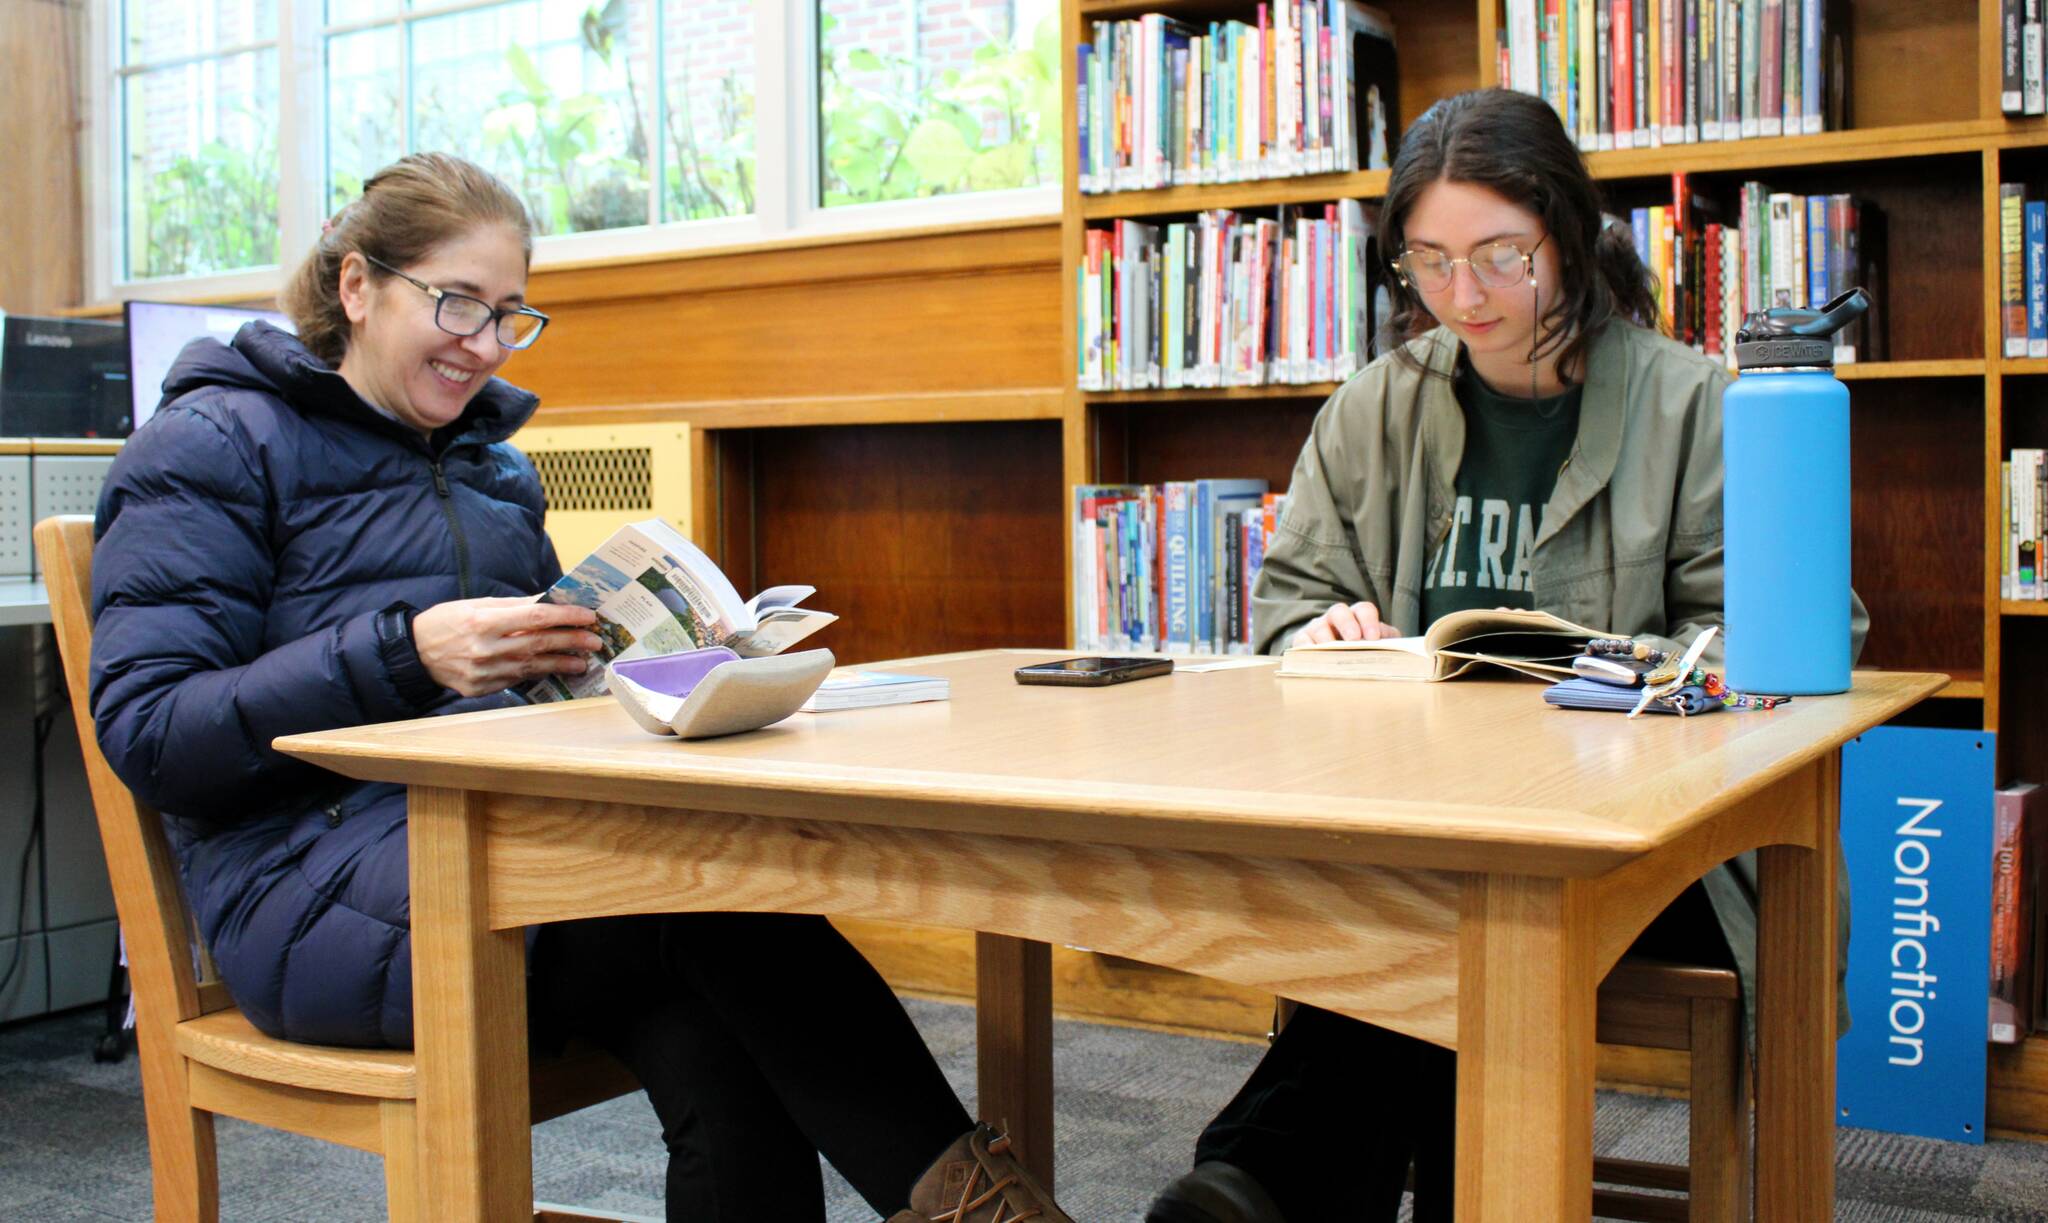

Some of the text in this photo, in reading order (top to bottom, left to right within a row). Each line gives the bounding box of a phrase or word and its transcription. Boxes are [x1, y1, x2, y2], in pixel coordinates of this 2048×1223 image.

[26, 331, 72, 348] Lenovo
[1169, 535, 1186, 633] QUILTING
[2000, 847, 2014, 875] 100
[1888, 797, 1943, 1066] Nonfiction
